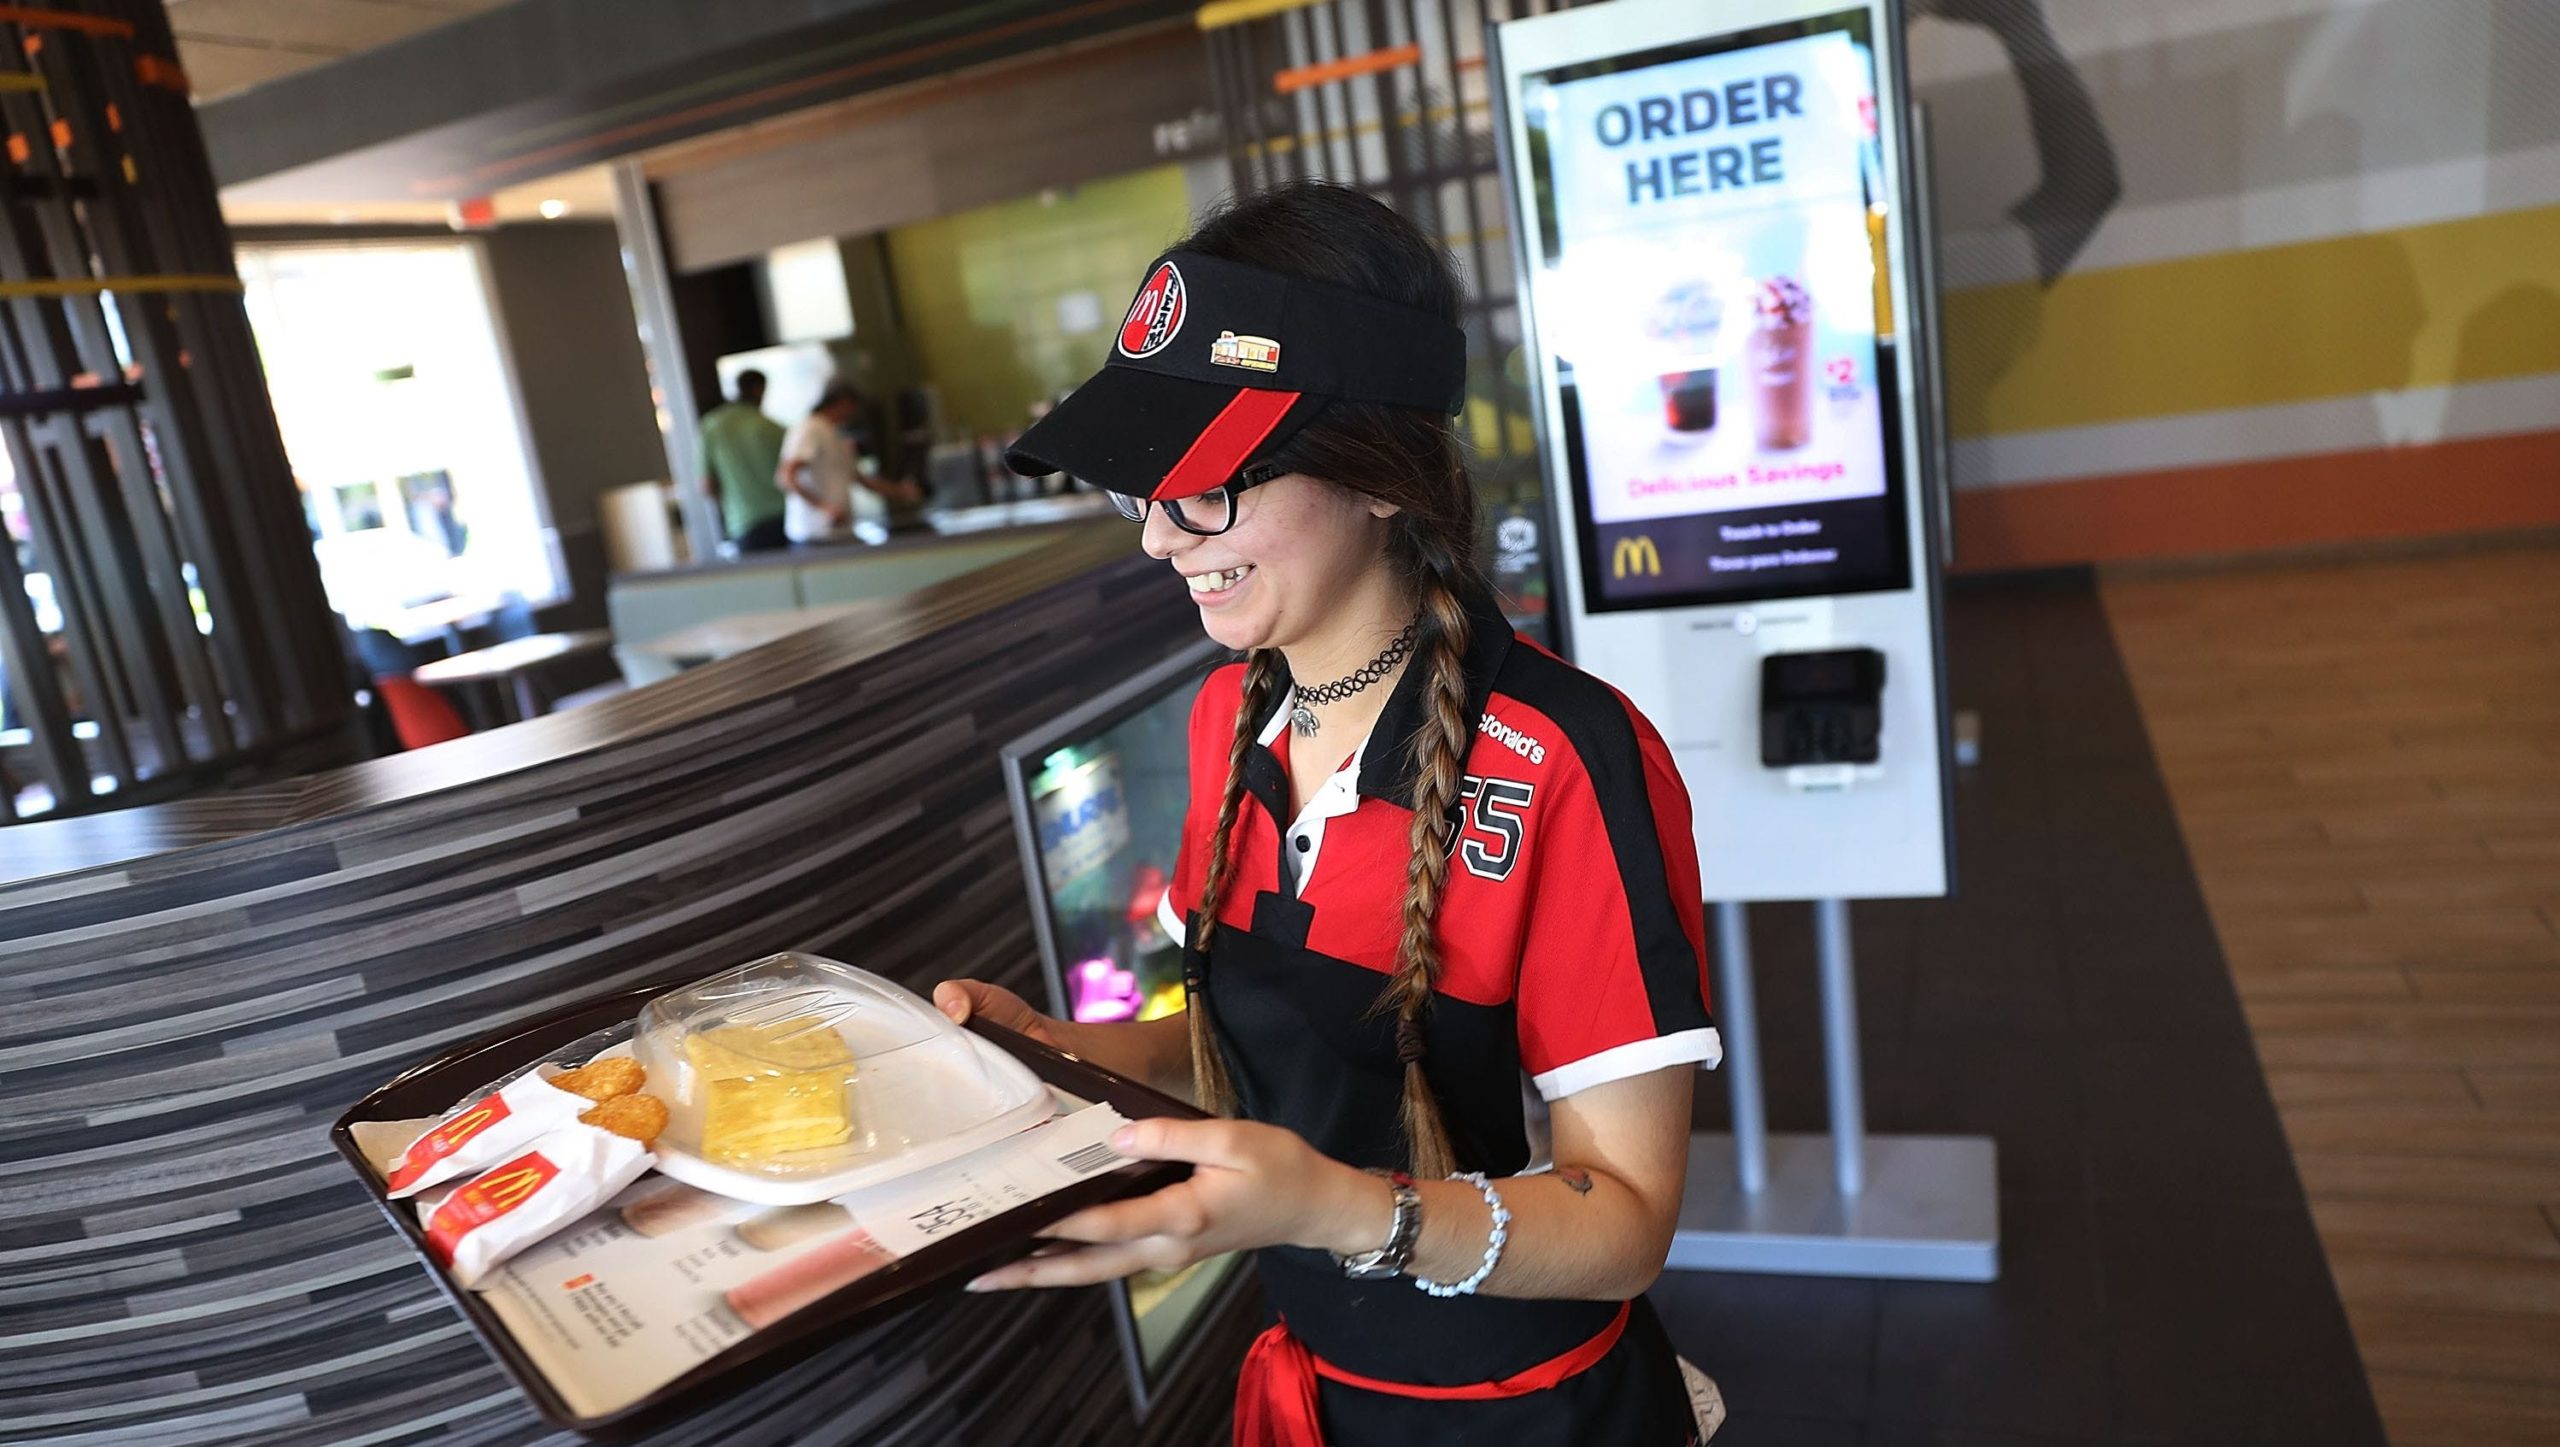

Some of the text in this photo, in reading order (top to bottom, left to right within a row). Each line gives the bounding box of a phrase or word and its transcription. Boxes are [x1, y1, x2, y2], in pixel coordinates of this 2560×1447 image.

[1596, 72, 1803, 148] ORDER
[1625, 138, 1785, 205] HERE
[1747, 461, 1845, 486] Savings
[1480, 713, 1547, 766] Donald's
